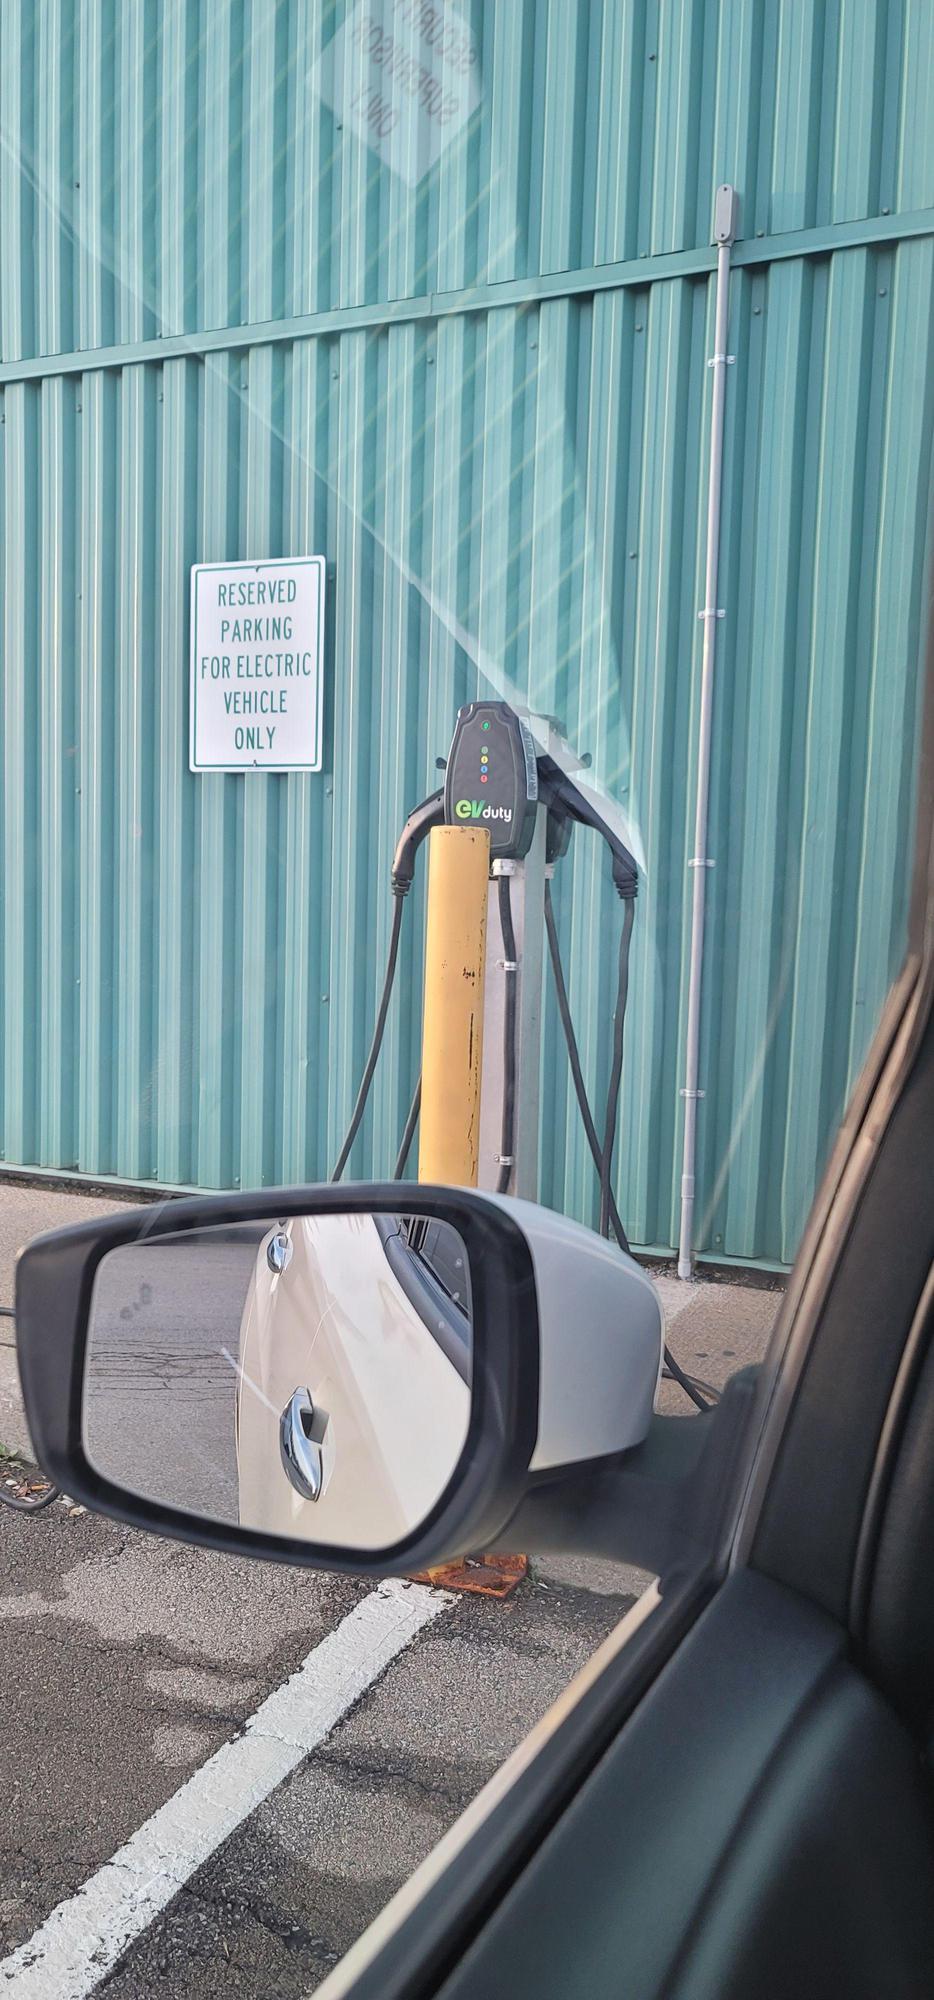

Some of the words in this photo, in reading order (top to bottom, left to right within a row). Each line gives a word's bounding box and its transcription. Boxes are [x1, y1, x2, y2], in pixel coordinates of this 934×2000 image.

[218, 579, 297, 607] RESERVED
[221, 616, 293, 643] PARKING
[201, 656, 231, 680] FOR
[237, 652, 311, 678] ELECTRIC
[223, 690, 288, 714] VEHICLE
[234, 727, 276, 750] ONLY
